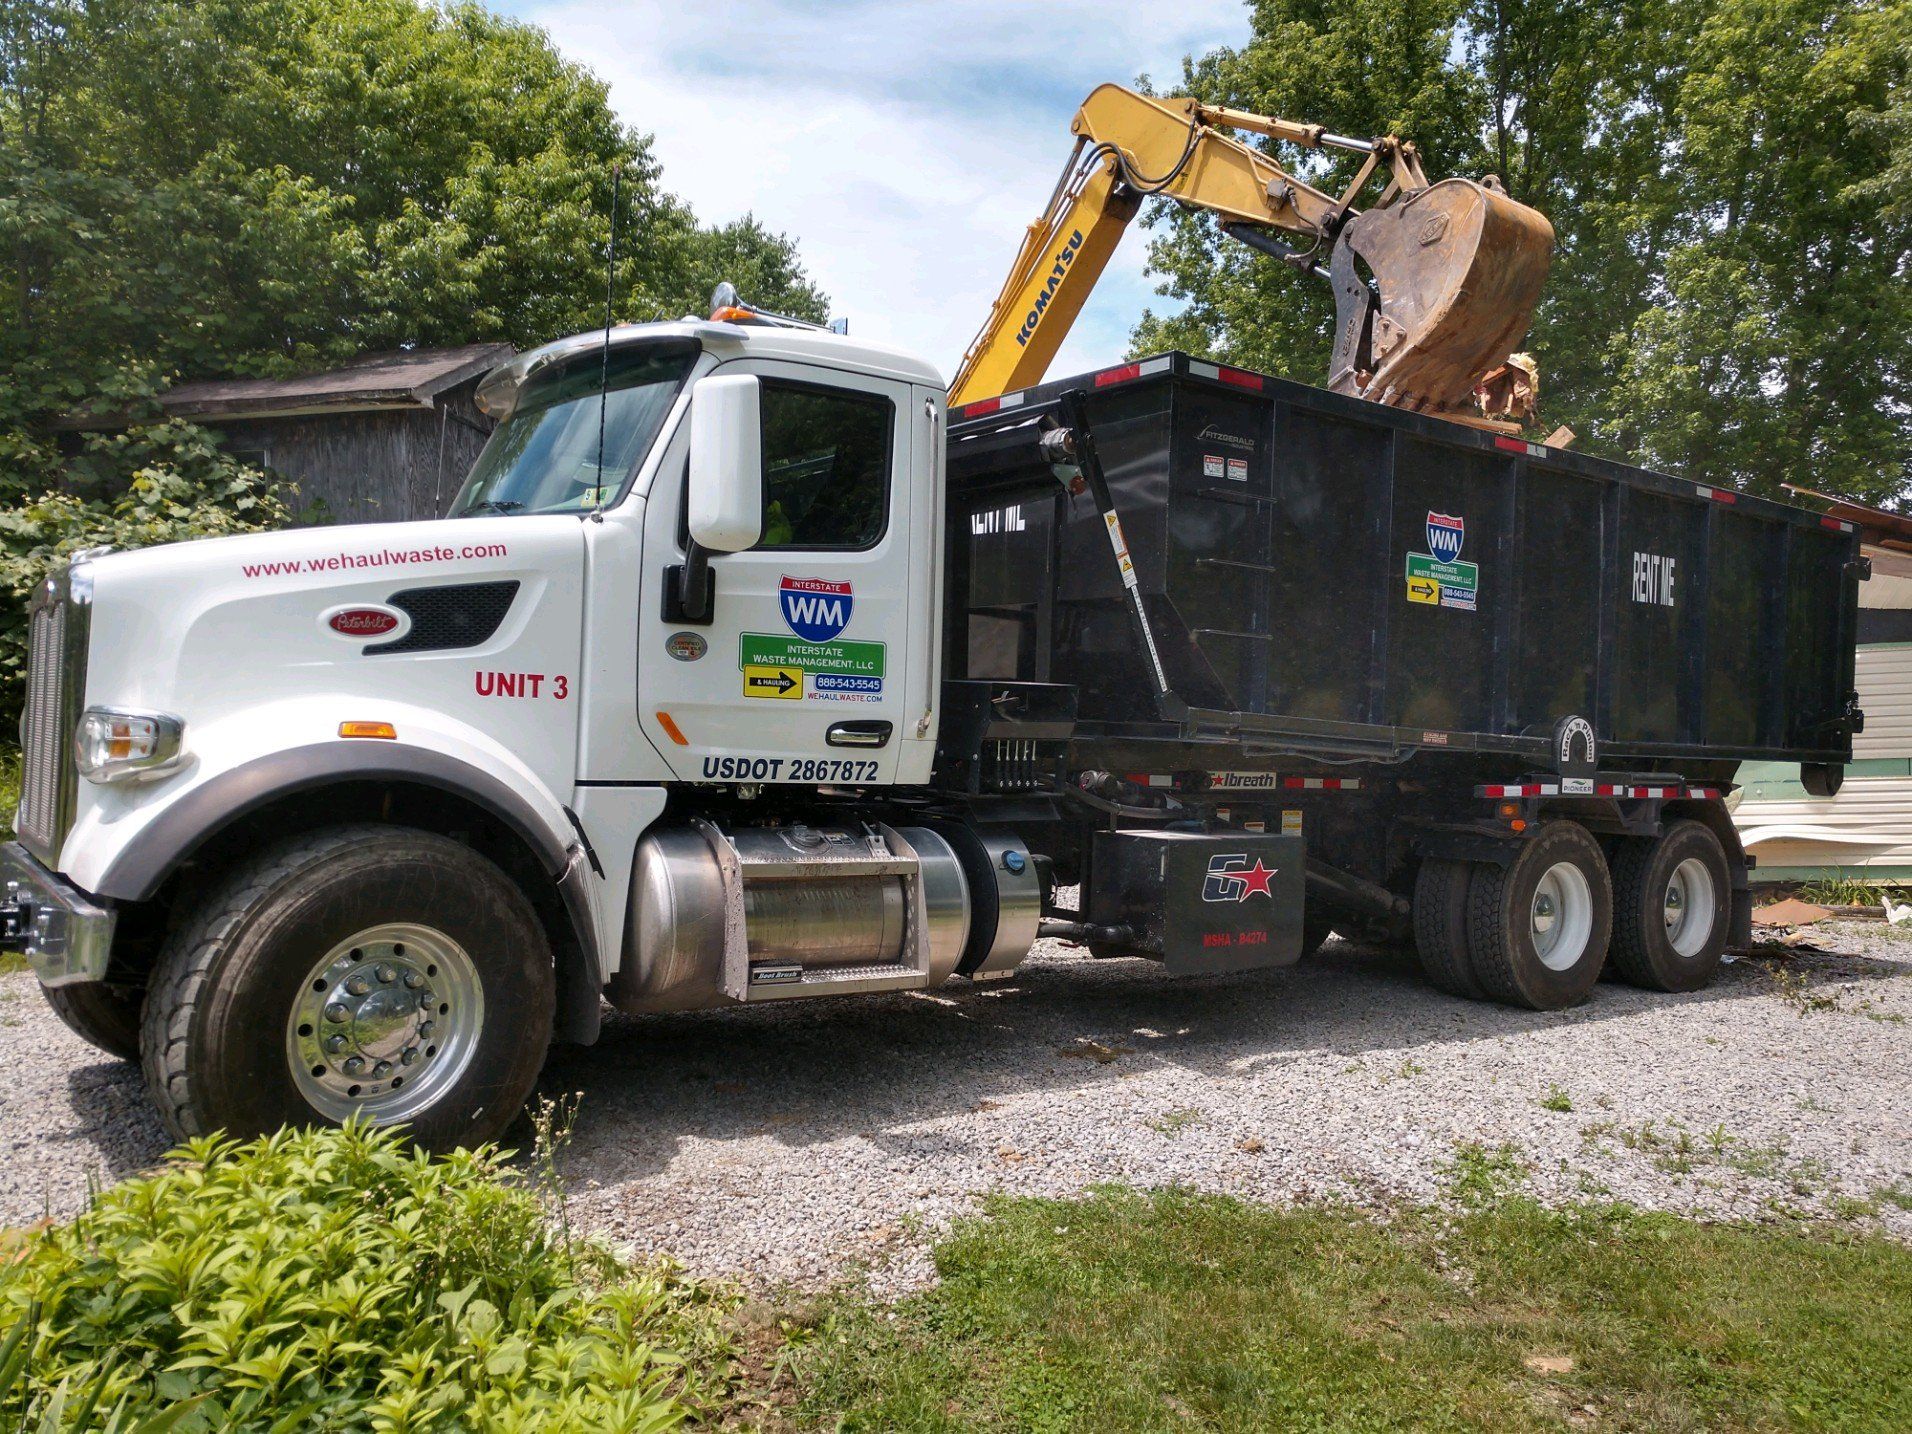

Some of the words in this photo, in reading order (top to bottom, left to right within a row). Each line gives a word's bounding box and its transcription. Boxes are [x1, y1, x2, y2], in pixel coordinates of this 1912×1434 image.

[1016, 229, 1083, 347] KOMATSU
[1204, 430, 1255, 446] FITZGERALD
[1433, 518, 1458, 527] INTERSTATE
[1430, 528, 1458, 552] WM
[242, 543, 508, 578] www.wehaulwaste.com
[1430, 563, 1458, 574] INTERSTATE
[1413, 569, 1430, 577] WASTE
[1632, 551, 1660, 604] RENT
[1660, 556, 1675, 606] ME
[792, 581, 841, 592] INTERSTATE
[787, 596, 844, 627] WM
[336, 614, 392, 631] Peterbilt
[787, 645, 843, 656] INTERSTATE
[753, 654, 786, 665] WASTE
[856, 661, 874, 670] LLC
[475, 671, 545, 699] UNIT
[553, 675, 569, 699] 3
[817, 677, 880, 690] 888-543-5545
[1562, 727, 1574, 757] Rack
[1582, 723, 1594, 760] Pinion
[703, 756, 784, 780] USDOT
[789, 759, 879, 781] 2867872
[1563, 785, 1592, 793] PIONEER
